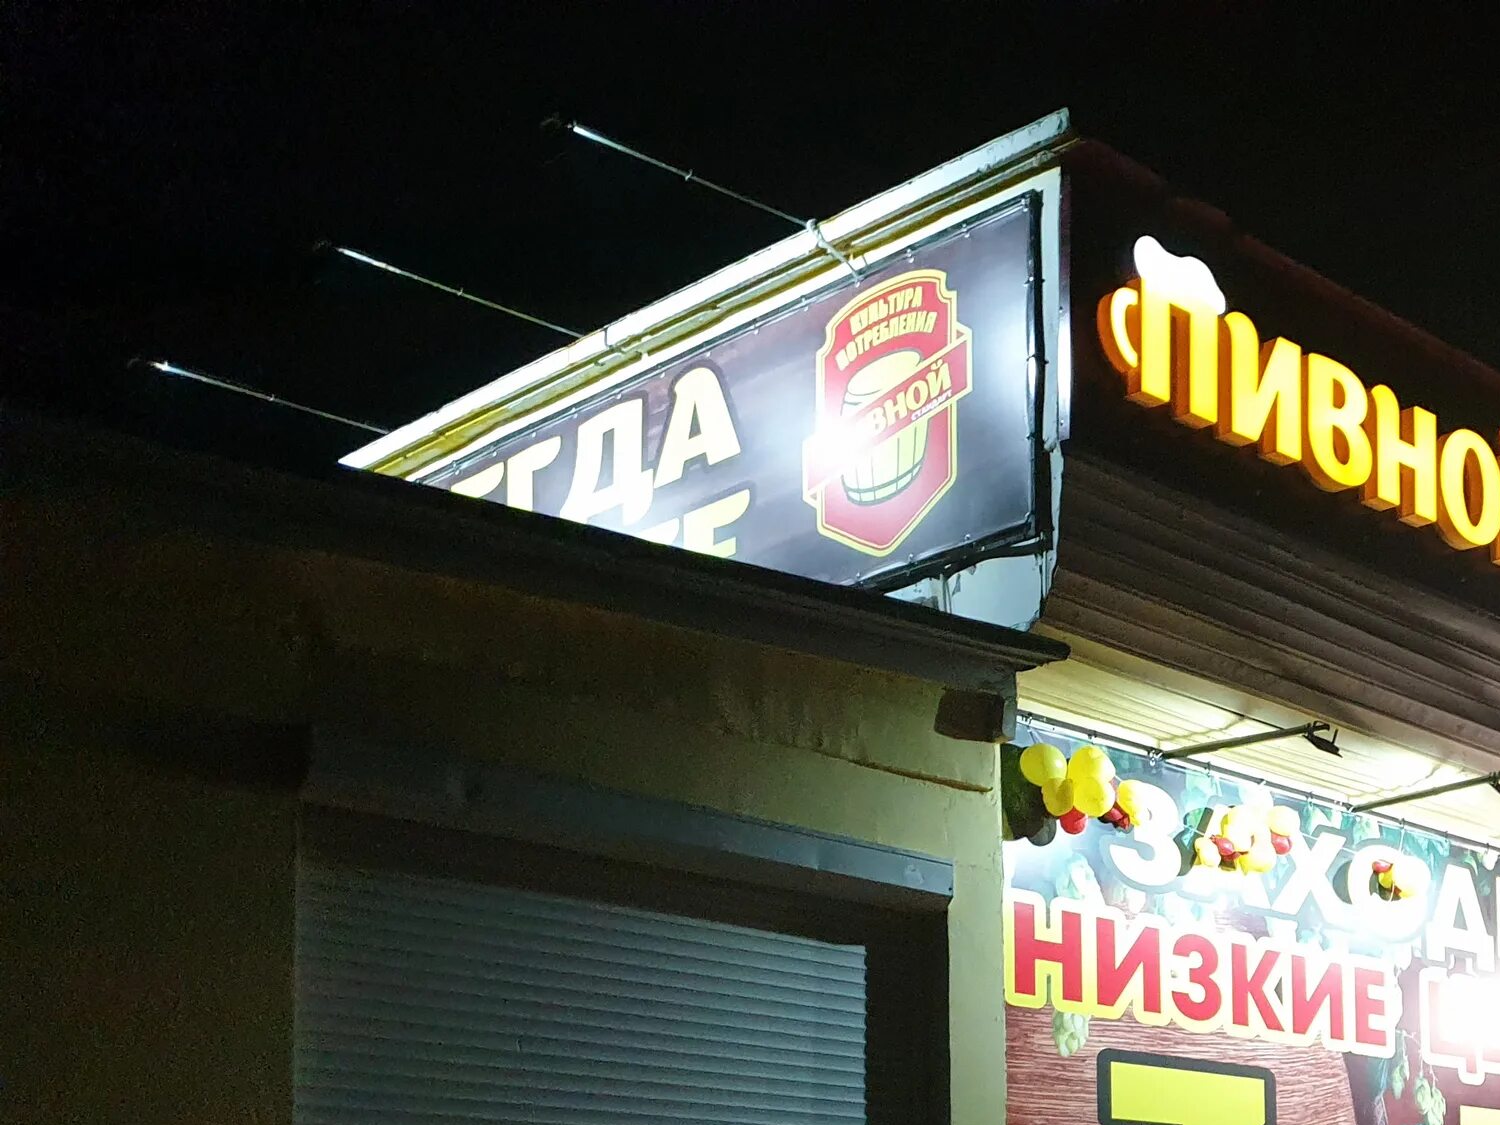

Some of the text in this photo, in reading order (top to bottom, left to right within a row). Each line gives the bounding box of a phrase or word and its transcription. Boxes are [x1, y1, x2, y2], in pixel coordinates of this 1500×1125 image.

[834, 310, 938, 371] ПОТРЕБЛЕНИЯ
[849, 285, 923, 336] КУЛЬТУРА
[1009, 897, 1392, 1048] НИЗКИЕ
